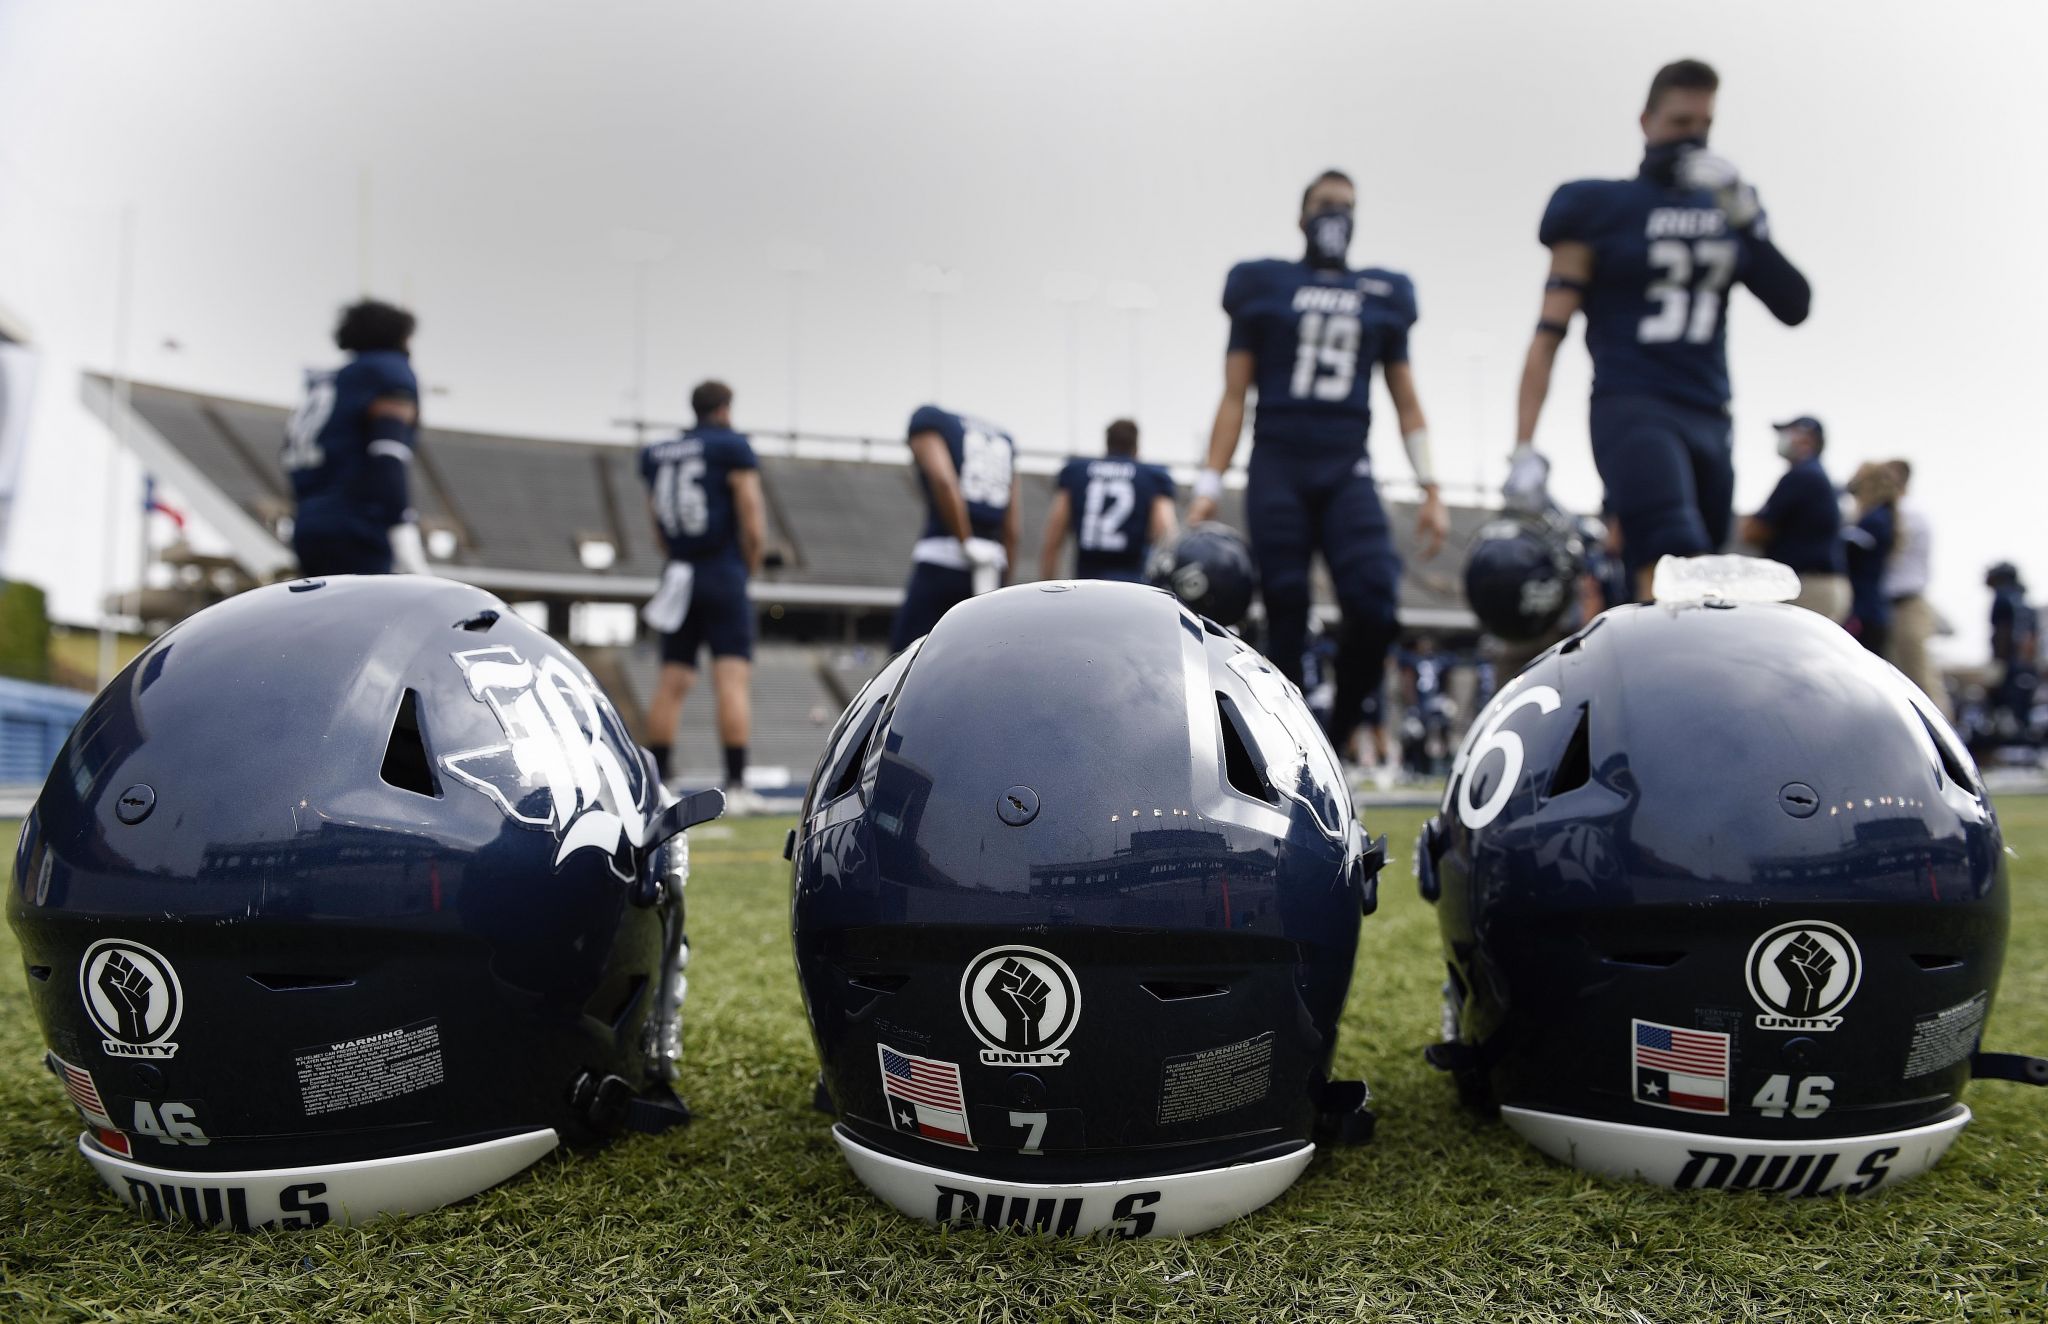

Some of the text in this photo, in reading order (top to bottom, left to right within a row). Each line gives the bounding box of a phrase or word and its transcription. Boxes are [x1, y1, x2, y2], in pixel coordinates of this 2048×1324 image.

[1637, 240, 1737, 343] 37
[1290, 312, 1361, 400] 19
[1081, 480, 1135, 550] 12
[331, 1029, 404, 1051] WARNING
[1760, 1018, 1839, 1029] UNITY
[104, 1043, 174, 1056] UNITY
[982, 1053, 1065, 1064] UNITY
[1196, 1042, 1250, 1060] WARNING
[1752, 1074, 1835, 1118] 46
[134, 1101, 210, 1146] 46
[1009, 1111, 1047, 1155] 7
[1674, 1147, 1900, 1200] OWLS
[122, 1175, 330, 1232] OWLS
[935, 1184, 1161, 1240] OWLS
